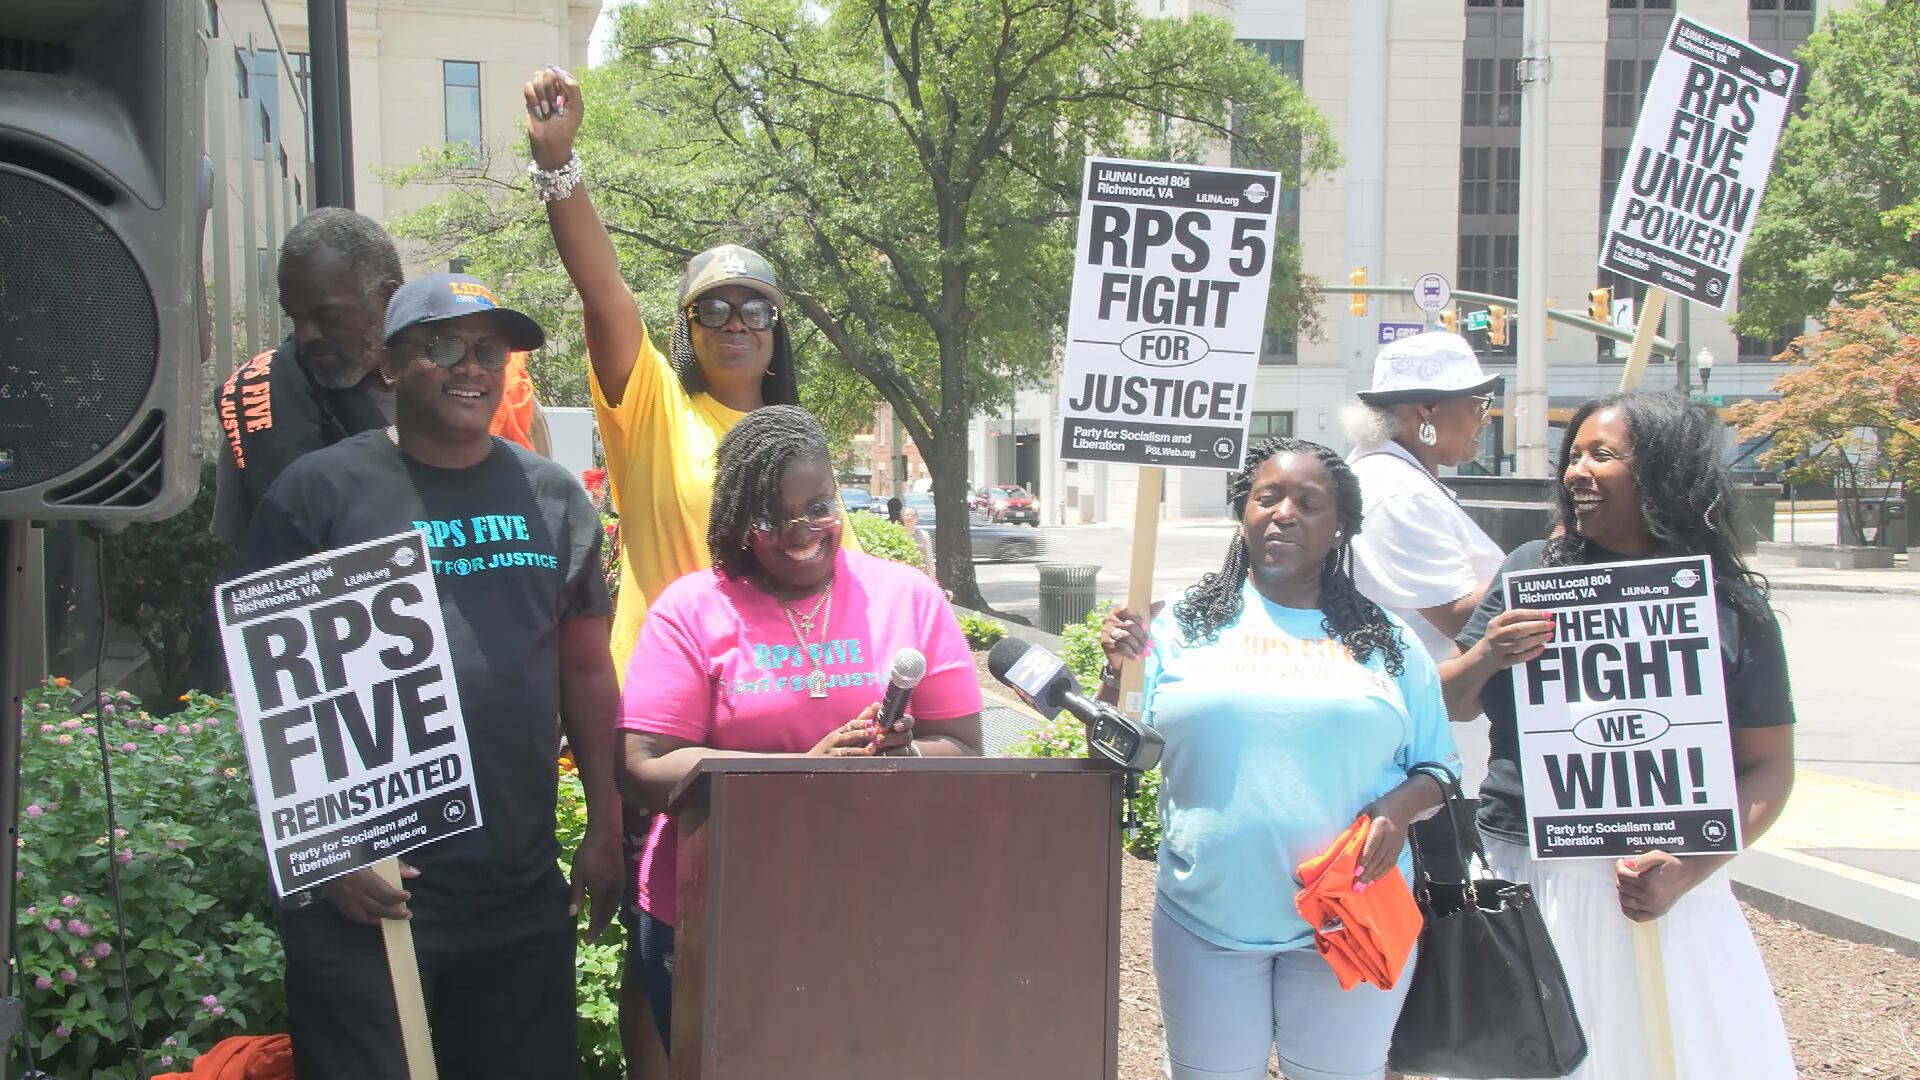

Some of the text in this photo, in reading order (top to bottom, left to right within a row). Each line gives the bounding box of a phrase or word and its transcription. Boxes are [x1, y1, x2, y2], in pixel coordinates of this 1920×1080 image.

[1679, 61, 1760, 134] RPS
[1665, 109, 1748, 178] FIVE
[1097, 182, 1174, 199] Richmond, VA
[1098, 169, 1190, 188] LiUNA! Local 804
[1631, 146, 1755, 234] UNION
[1196, 193, 1240, 207] LiUNA.org
[1088, 205, 1267, 277] RPS 5
[1620, 197, 1736, 268] POWER!
[720, 249, 747, 273] LA
[1098, 272, 1240, 329] FIGHT
[1140, 335, 1189, 361] FOR
[241, 381, 272, 433] FIVE
[1069, 373, 1247, 422] JUSTICE!
[1072, 438, 1125, 452] Liberation
[1074, 426, 1192, 444] Party for Socialism and
[1144, 445, 1196, 459] PSLWeb.org
[412, 515, 530, 548] RPS FIVE
[488, 552, 558, 570] JUSTICE
[276, 573, 310, 591] Local
[301, 583, 321, 598] VA
[1518, 575, 1612, 592] LiUNA! Local 804
[1621, 585, 1669, 597] LiUNA.org
[1519, 587, 1597, 604] Richmond, VA
[1638, 602, 1699, 636] WE
[241, 581, 435, 713] RPS
[754, 643, 803, 668] RPS
[1525, 636, 1709, 706] FIGHT
[258, 664, 457, 800] FIVE
[1596, 714, 1645, 743] WE
[1543, 747, 1708, 810] WIN!
[271, 753, 462, 841] REINSTATED
[289, 812, 418, 865] Party for Socialism and
[1546, 820, 1676, 837] Party for Socialism and
[1547, 834, 1604, 847] Liberation
[1626, 835, 1684, 846] PSLWeb.org
[292, 850, 351, 877] Liberation
